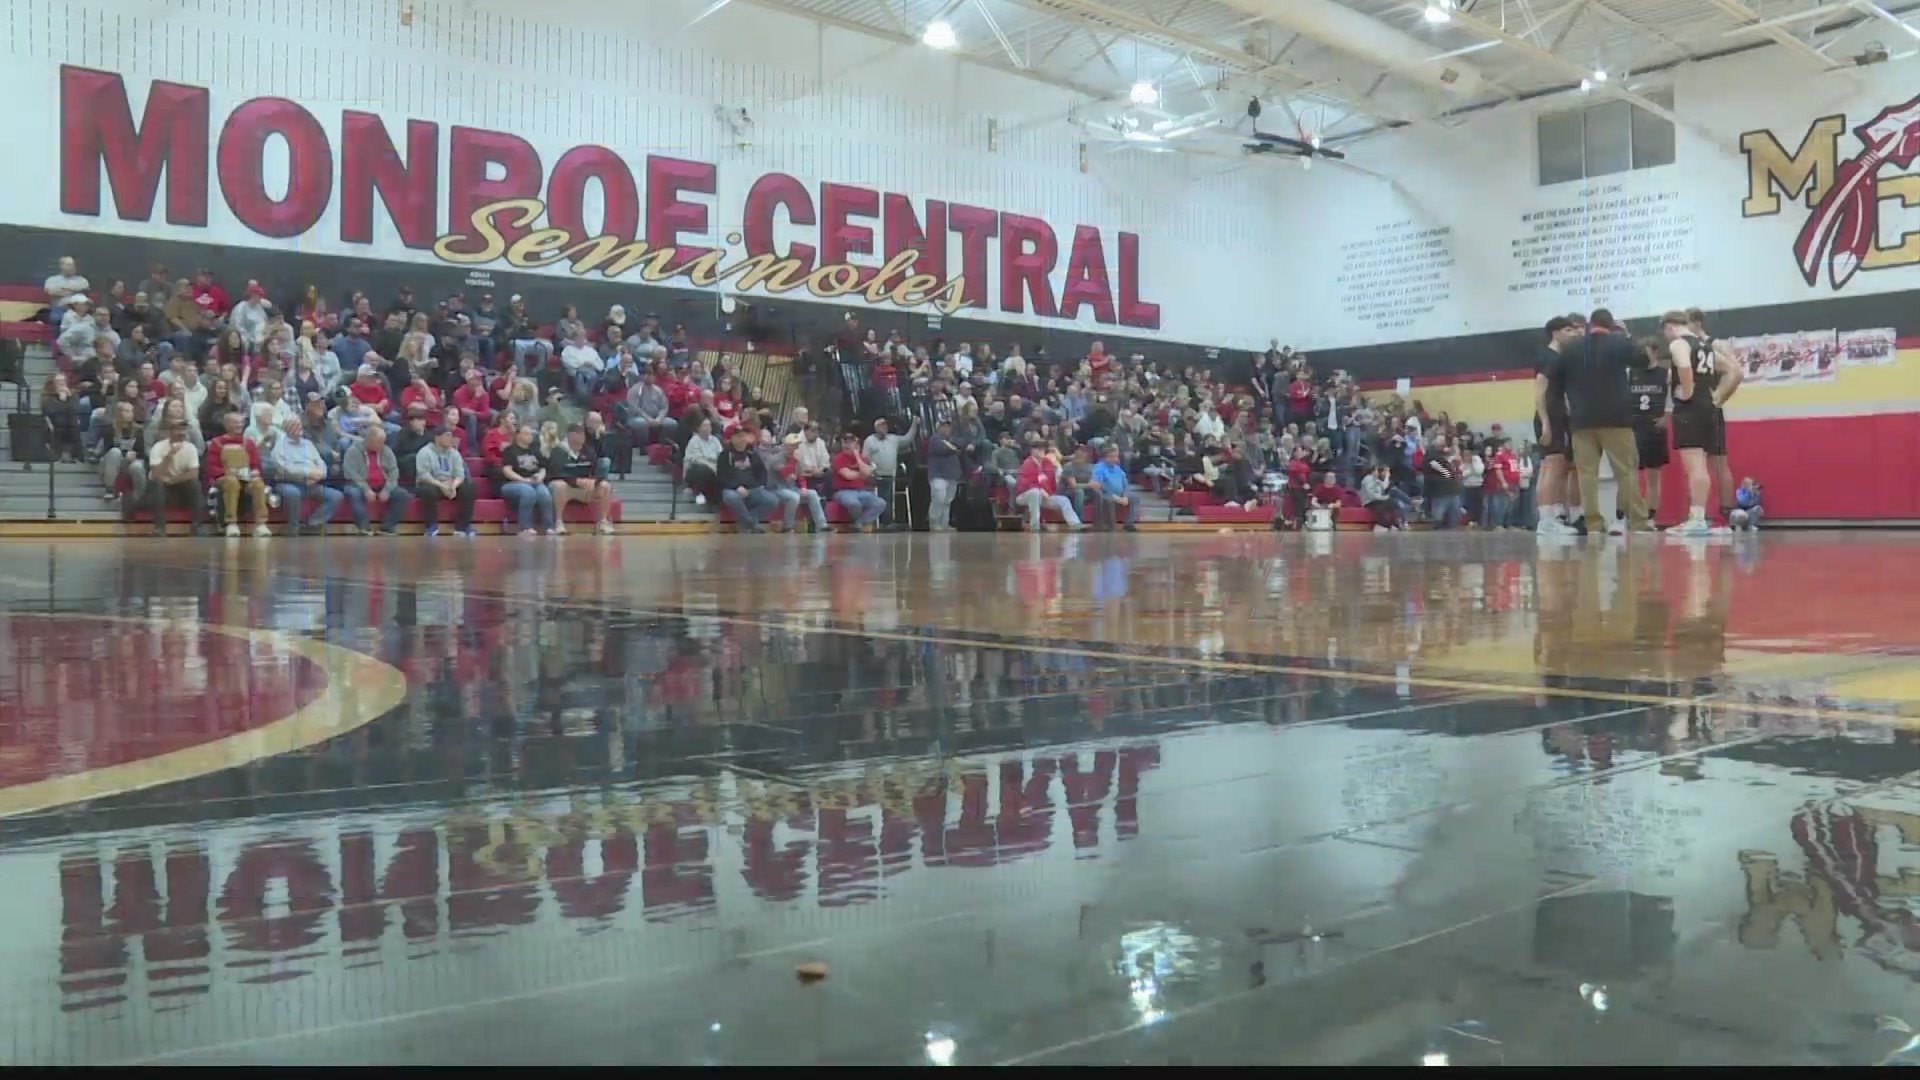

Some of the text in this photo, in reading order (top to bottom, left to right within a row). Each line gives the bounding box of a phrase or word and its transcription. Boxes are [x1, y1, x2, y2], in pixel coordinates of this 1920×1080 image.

[60, 63, 1160, 330] MONROE CENTRAL
[1739, 113, 1846, 218] M
[433, 198, 975, 315] Seminoles
[1639, 394, 1650, 411] 2
[1696, 349, 1714, 374] 24
